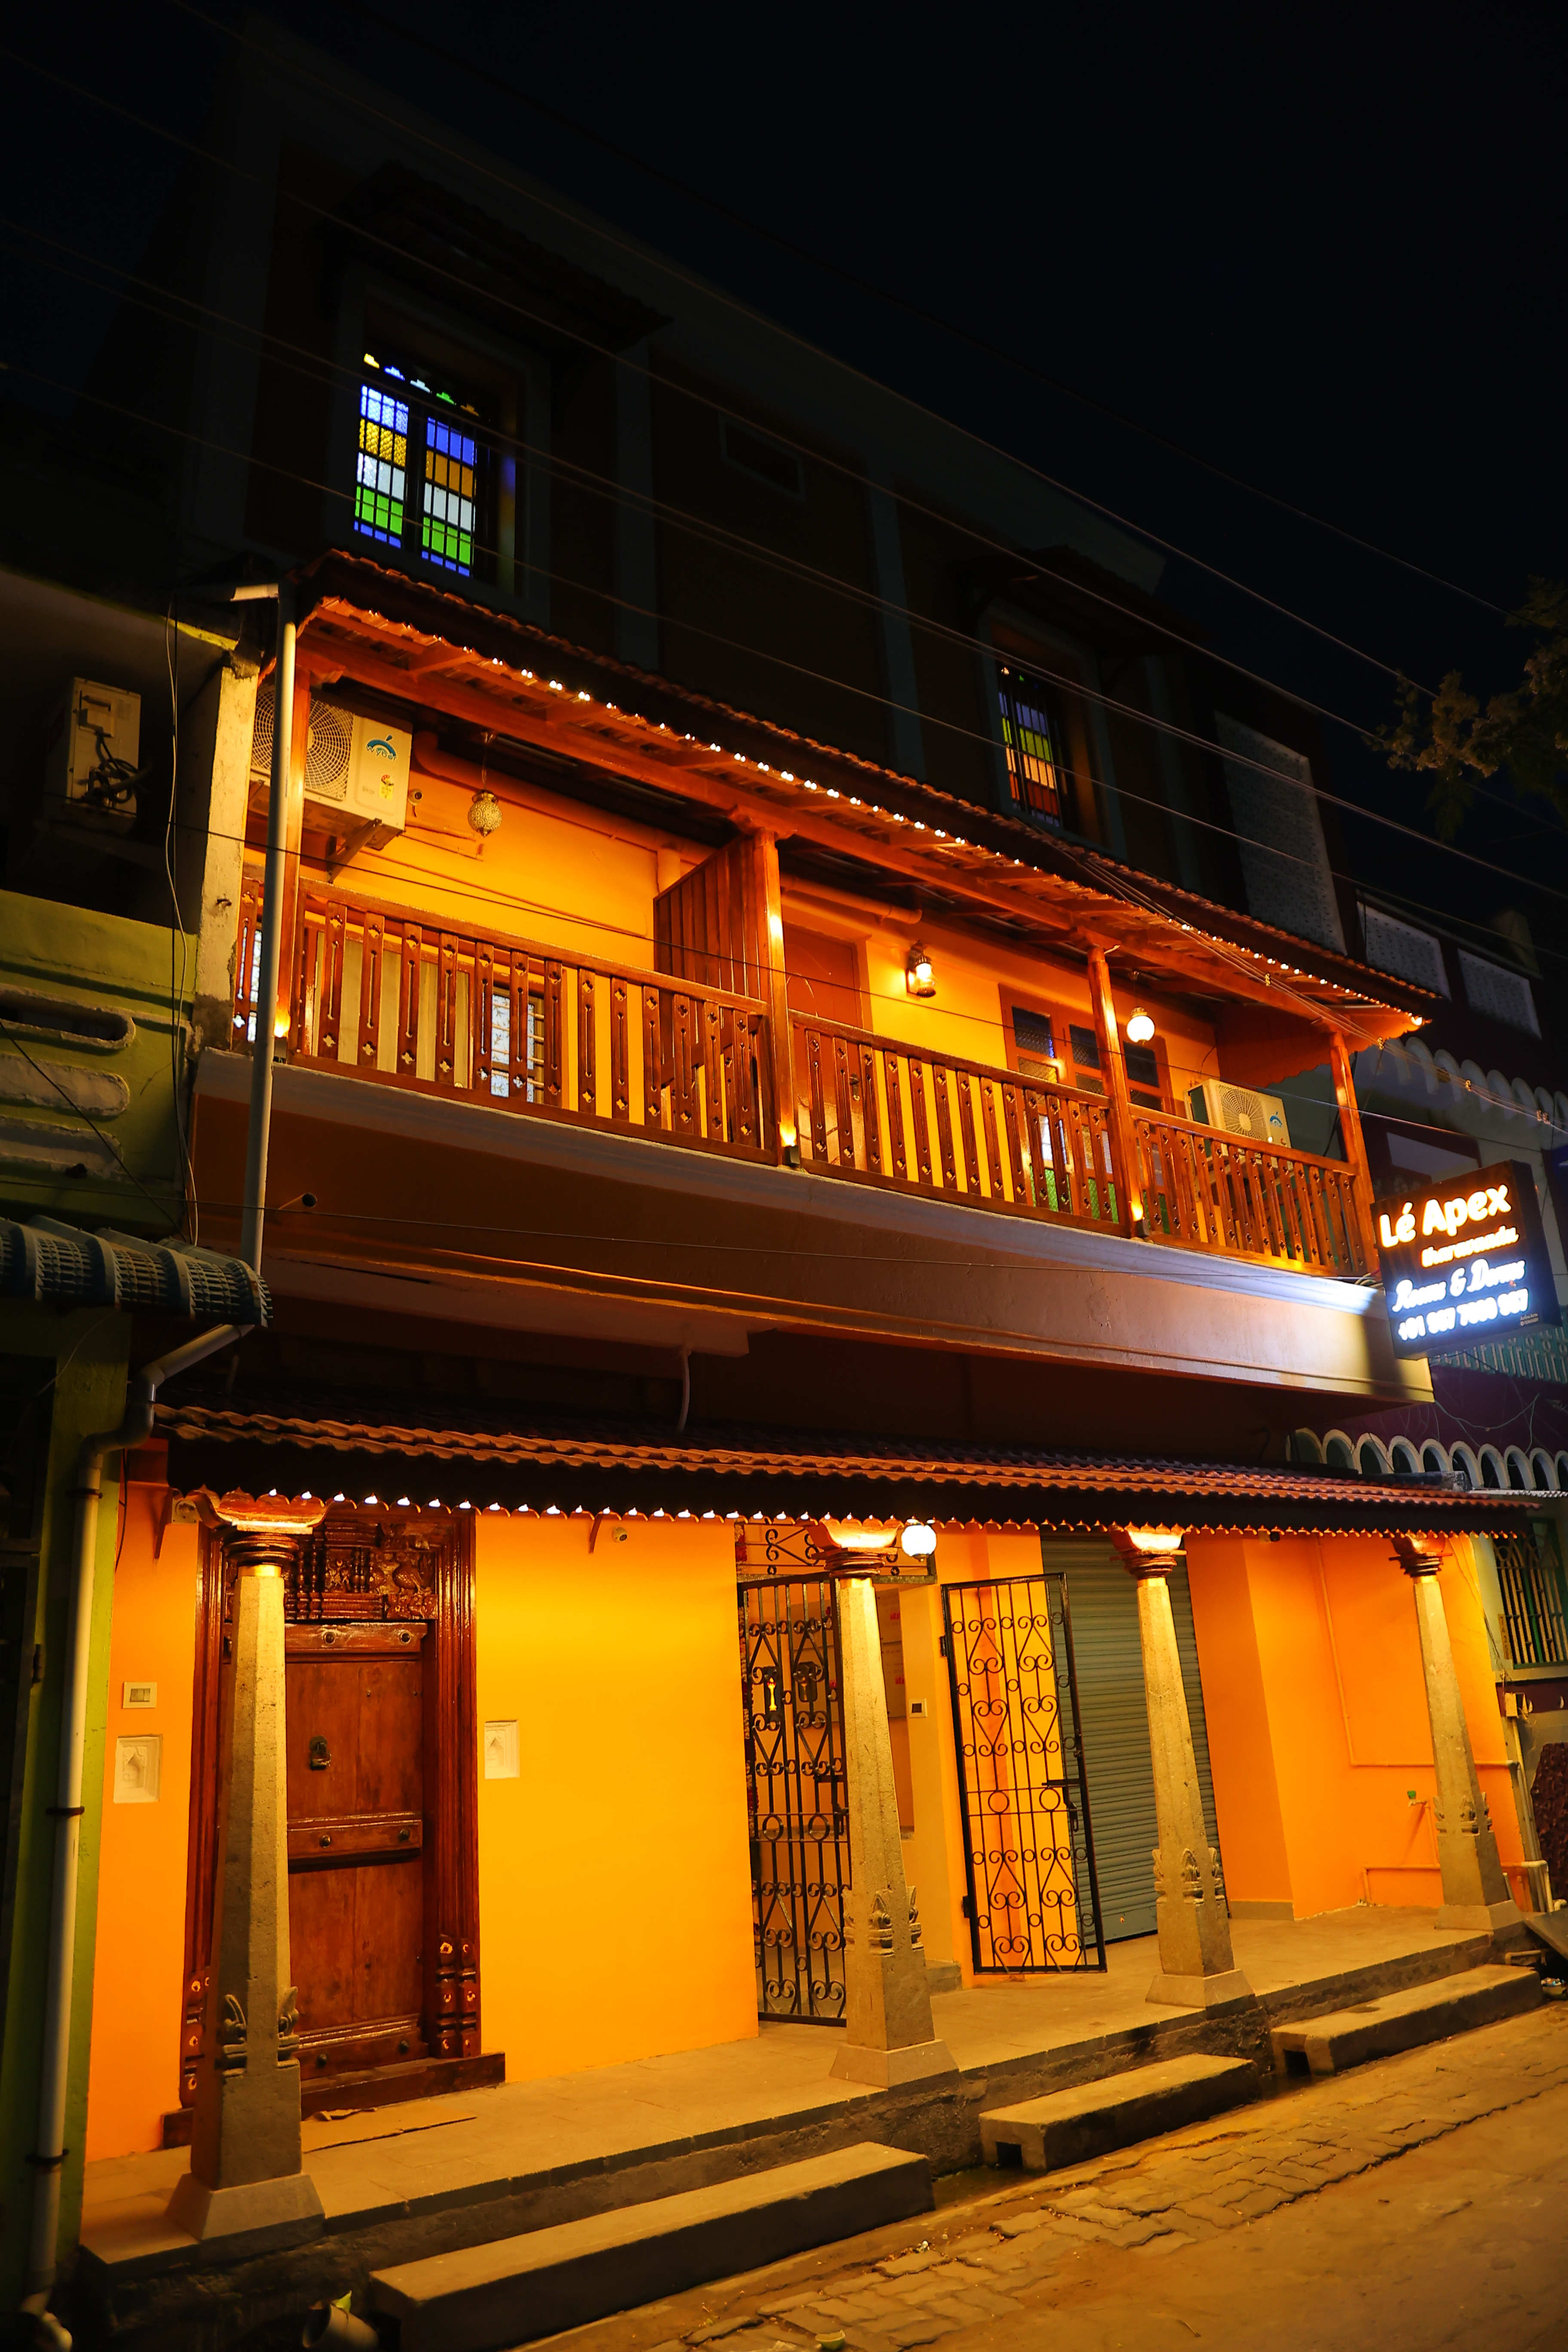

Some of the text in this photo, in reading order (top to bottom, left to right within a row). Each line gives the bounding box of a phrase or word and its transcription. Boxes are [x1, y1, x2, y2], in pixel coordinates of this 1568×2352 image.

[1380, 1184, 1511, 1247] Lé Apex
[1450, 1268, 1466, 1296] &
